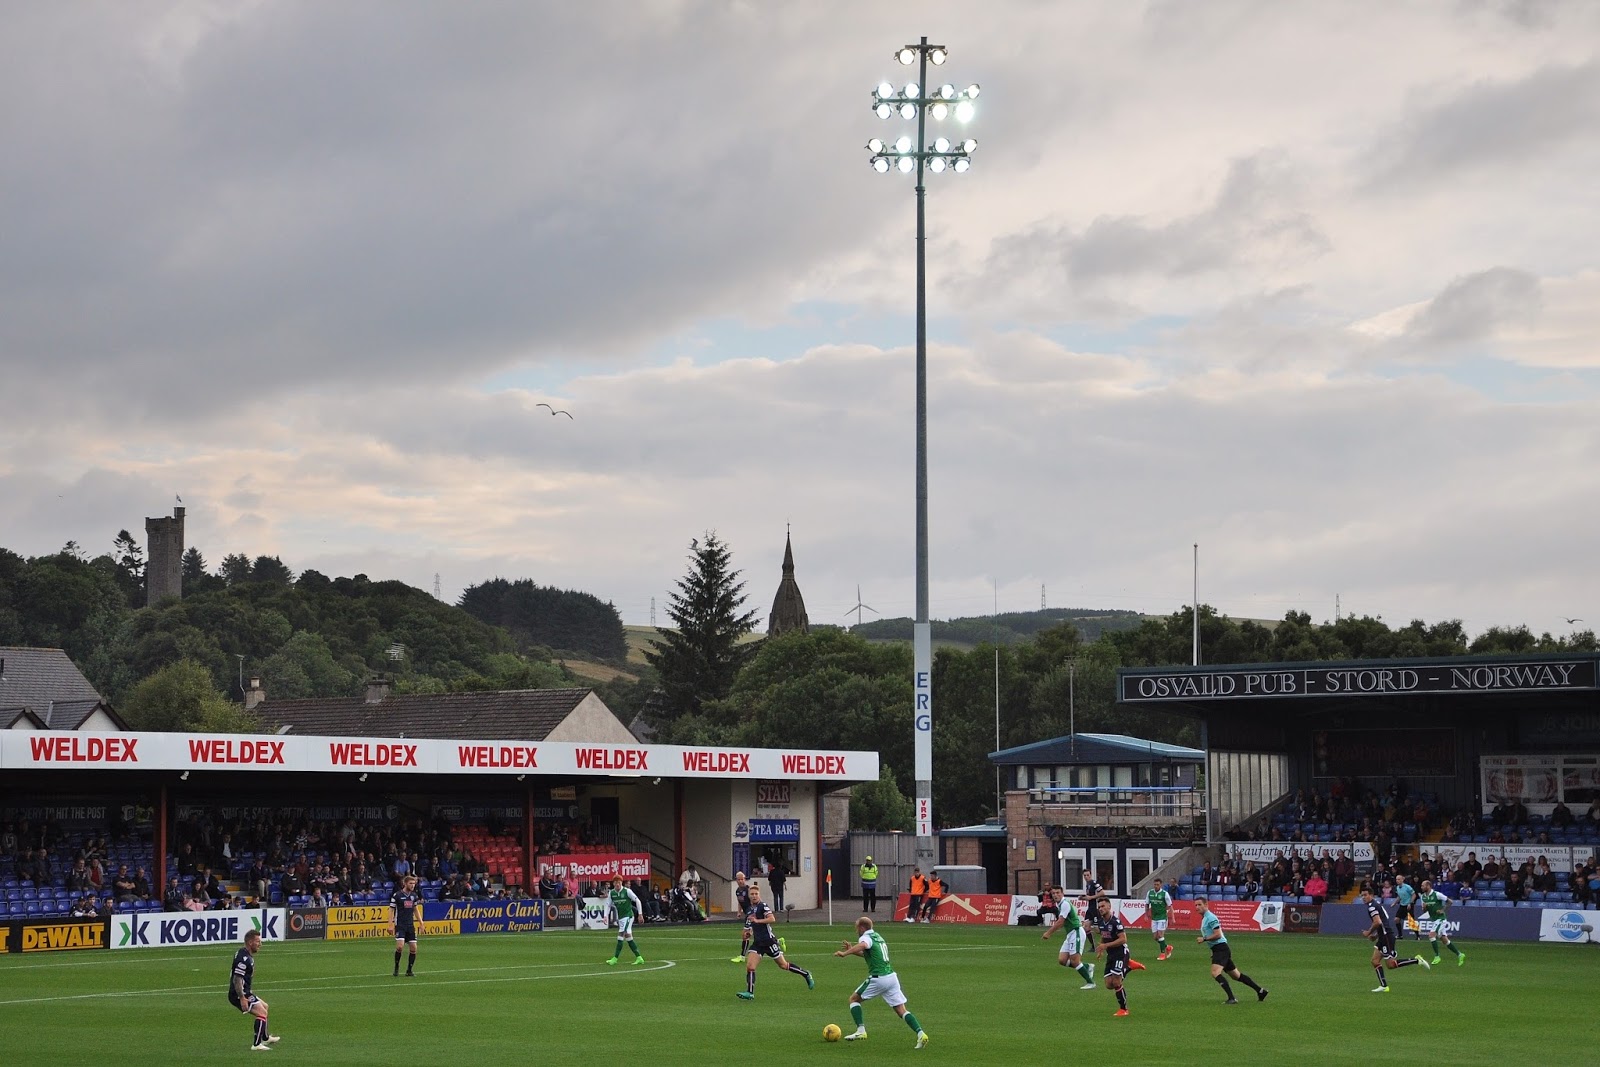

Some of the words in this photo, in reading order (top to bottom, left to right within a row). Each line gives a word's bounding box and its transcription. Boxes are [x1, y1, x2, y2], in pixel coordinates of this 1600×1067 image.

[1138, 675, 1236, 697] OSVALD
[1244, 673, 1297, 694] PUB
[1325, 669, 1419, 692] STORD
[1450, 664, 1576, 689] NORWAY
[30, 737, 138, 762] WELDEX
[189, 740, 285, 764] WELDEX
[330, 743, 418, 767] WELDEX
[458, 746, 538, 768] WELDEX
[575, 749, 648, 770] WELDEX
[683, 752, 750, 772] WELDEX
[782, 755, 846, 774] WELDEX
[758, 785, 790, 802] STAR
[56, 807, 69, 820] HIT
[70, 807, 86, 819] THE
[87, 807, 107, 819] POST
[755, 825, 772, 835] TEA
[775, 825, 793, 835] BAR
[570, 862, 610, 875] Record
[622, 859, 649, 876] mail
[337, 909, 366, 921] 01463
[370, 908, 382, 920] 22
[445, 902, 503, 920] Anderson
[506, 902, 541, 918] Clark
[580, 904, 605, 920] SIGN
[931, 914, 956, 923] Roofing
[956, 914, 968, 922] Ltd
[160, 917, 238, 944] KORRIE
[477, 922, 503, 932] Motor
[508, 921, 541, 932] Repairs
[1403, 920, 1460, 931] EEON
[770, 944, 779, 953] 18
[1382, 945, 1388, 953] 8
[1114, 960, 1123, 969] 10
